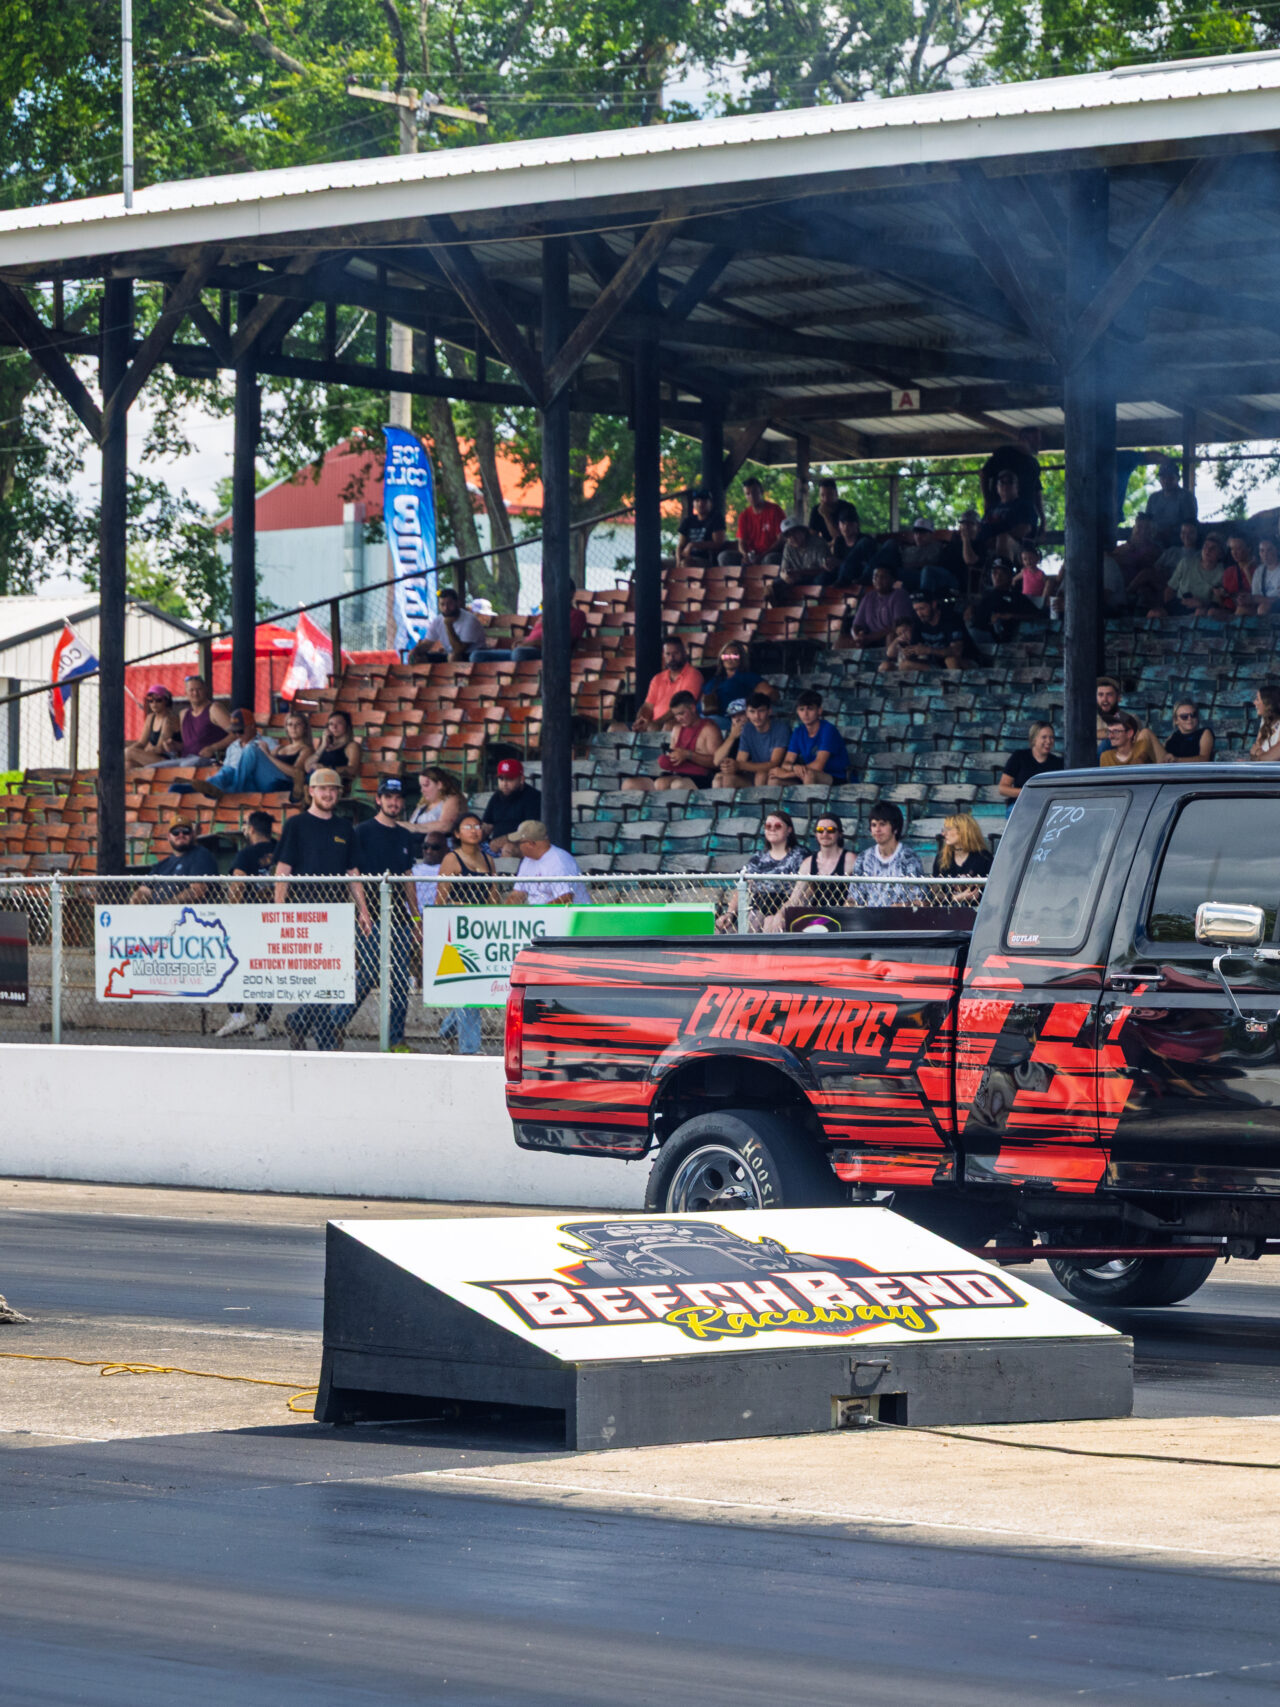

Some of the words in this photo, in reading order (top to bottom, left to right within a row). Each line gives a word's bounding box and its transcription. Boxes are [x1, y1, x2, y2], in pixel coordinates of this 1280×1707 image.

[899, 391, 913, 408] A
[1046, 805, 1085, 827] 7.70
[1042, 824, 1070, 842] ET
[261, 912, 280, 923] VISIT
[282, 912, 294, 923] THE
[296, 911, 328, 923] MUSEUM
[280, 928, 294, 938] AND
[296, 927, 309, 938] SEE
[457, 915, 546, 940] BOWLING
[109, 936, 230, 959] KENTUCKY
[267, 943, 279, 954] THE
[282, 943, 312, 954] HISTORY
[314, 943, 323, 954] OF
[485, 943, 531, 962] GRE
[132, 960, 217, 984] Motorsports
[249, 959, 285, 970] KENTUCKY
[288, 959, 341, 970] MOTORSPORTS
[243, 976, 262, 984] 200
[289, 976, 317, 984] Street
[243, 990, 274, 999] Central
[298, 990, 311, 999] KY
[684, 985, 898, 1057] FIREWIRE
[665, 1303, 925, 1338] Raceway
